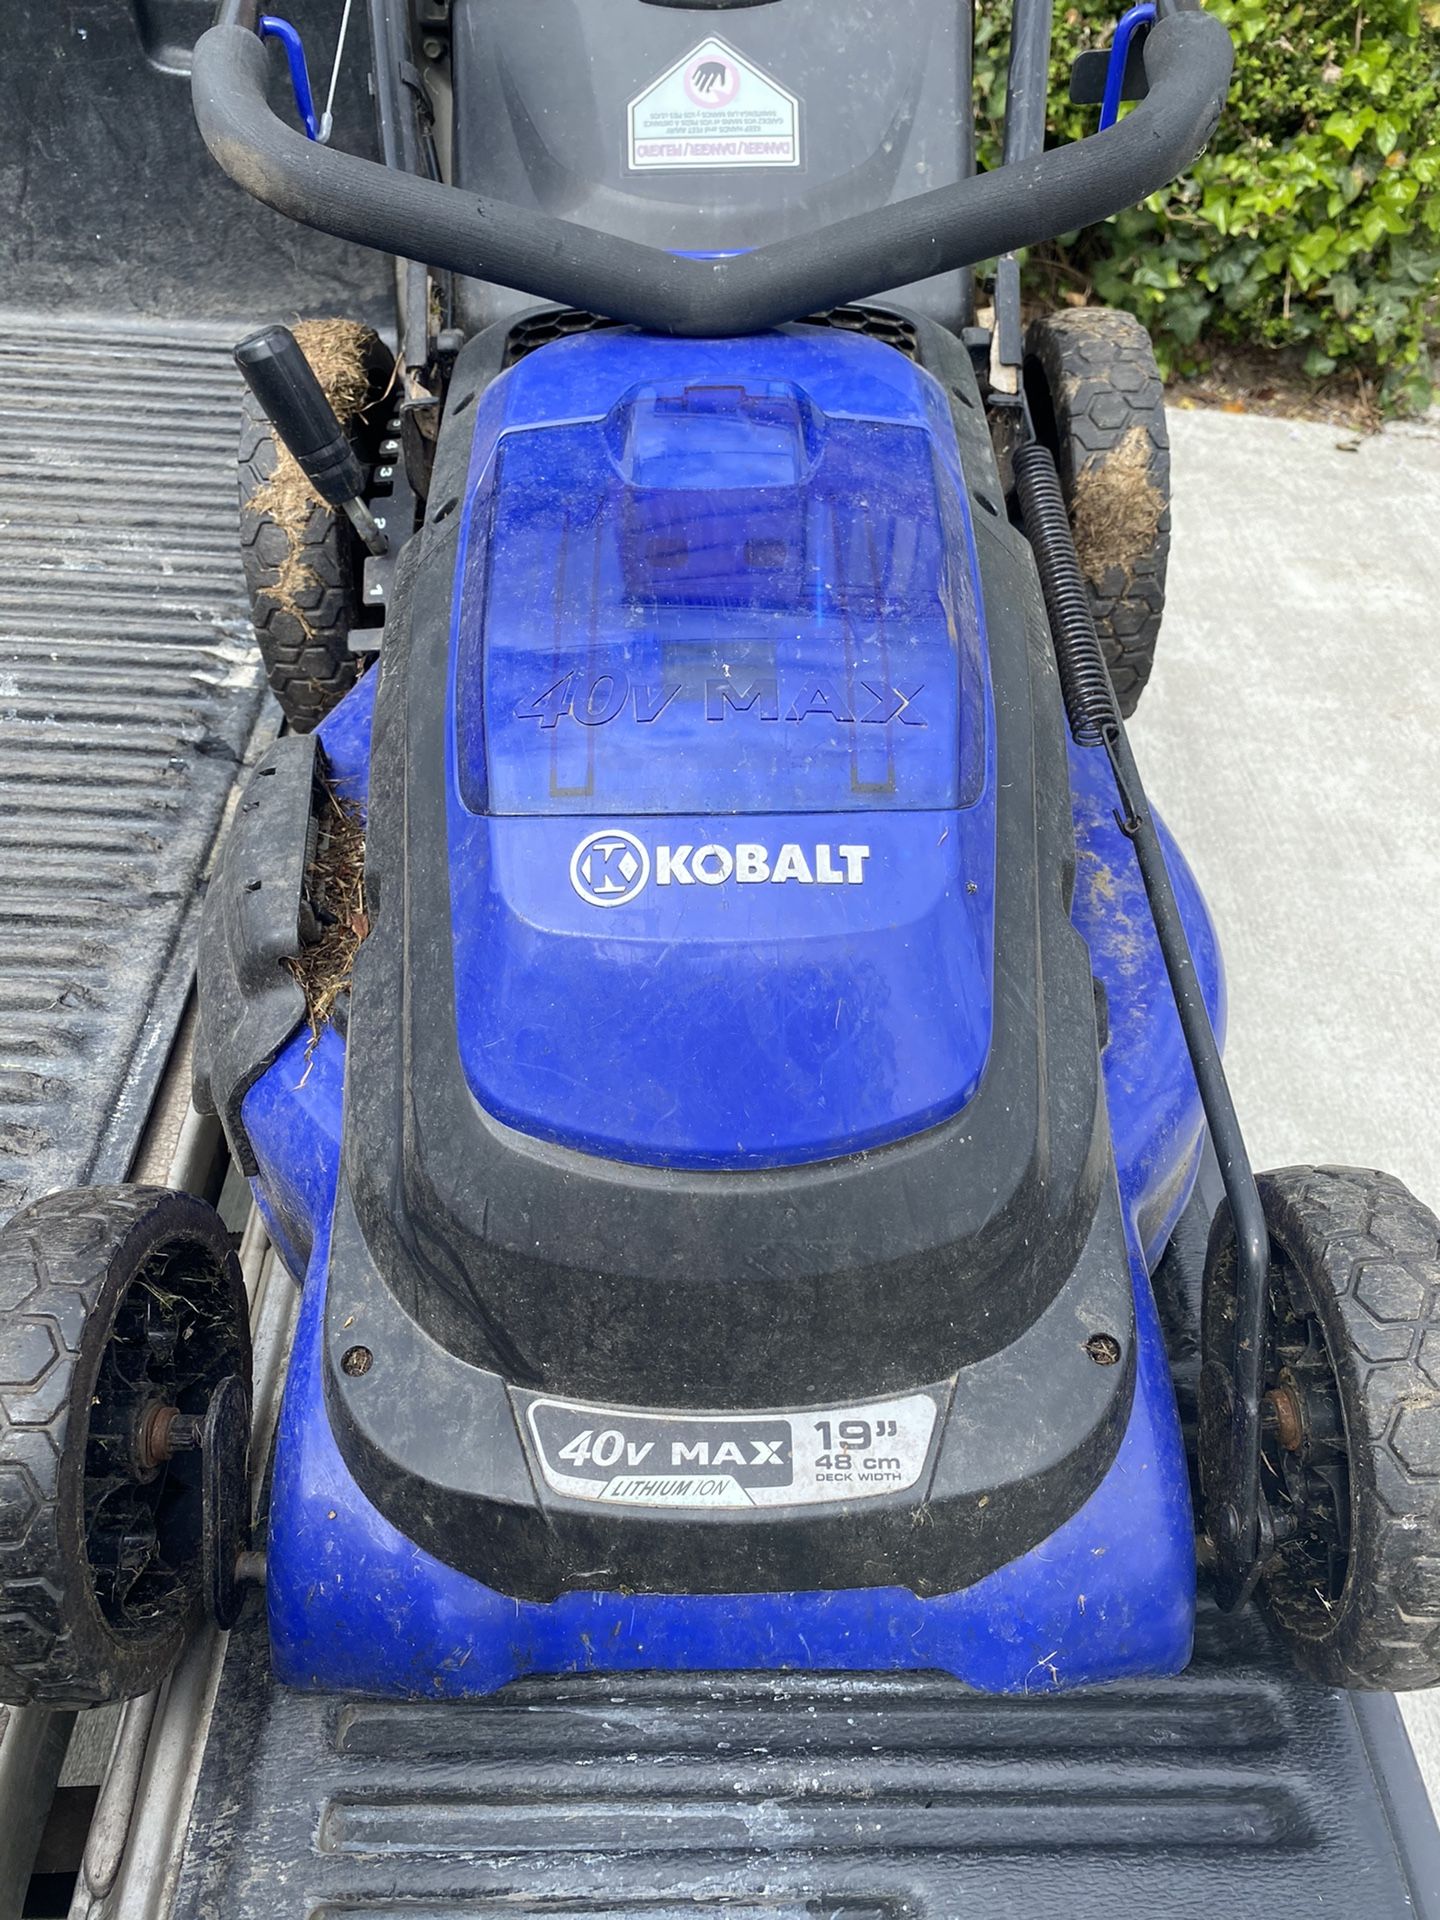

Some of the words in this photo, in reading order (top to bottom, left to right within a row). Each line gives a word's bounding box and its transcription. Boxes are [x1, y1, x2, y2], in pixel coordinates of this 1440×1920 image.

[385, 439, 399, 450] 4
[379, 466, 393, 477] 3
[369, 583, 384, 595] 1
[705, 678, 928, 727] MAX
[656, 844, 870, 886] KOBALT
[671, 1441, 784, 1466] MAX
[815, 1454, 852, 1470] 48
[863, 1458, 900, 1470] cm
[816, 1473, 853, 1482] DECK
[858, 1472, 901, 1481] WIDTH
[611, 1480, 692, 1497] LITHIUM
[692, 1479, 730, 1496] ION
